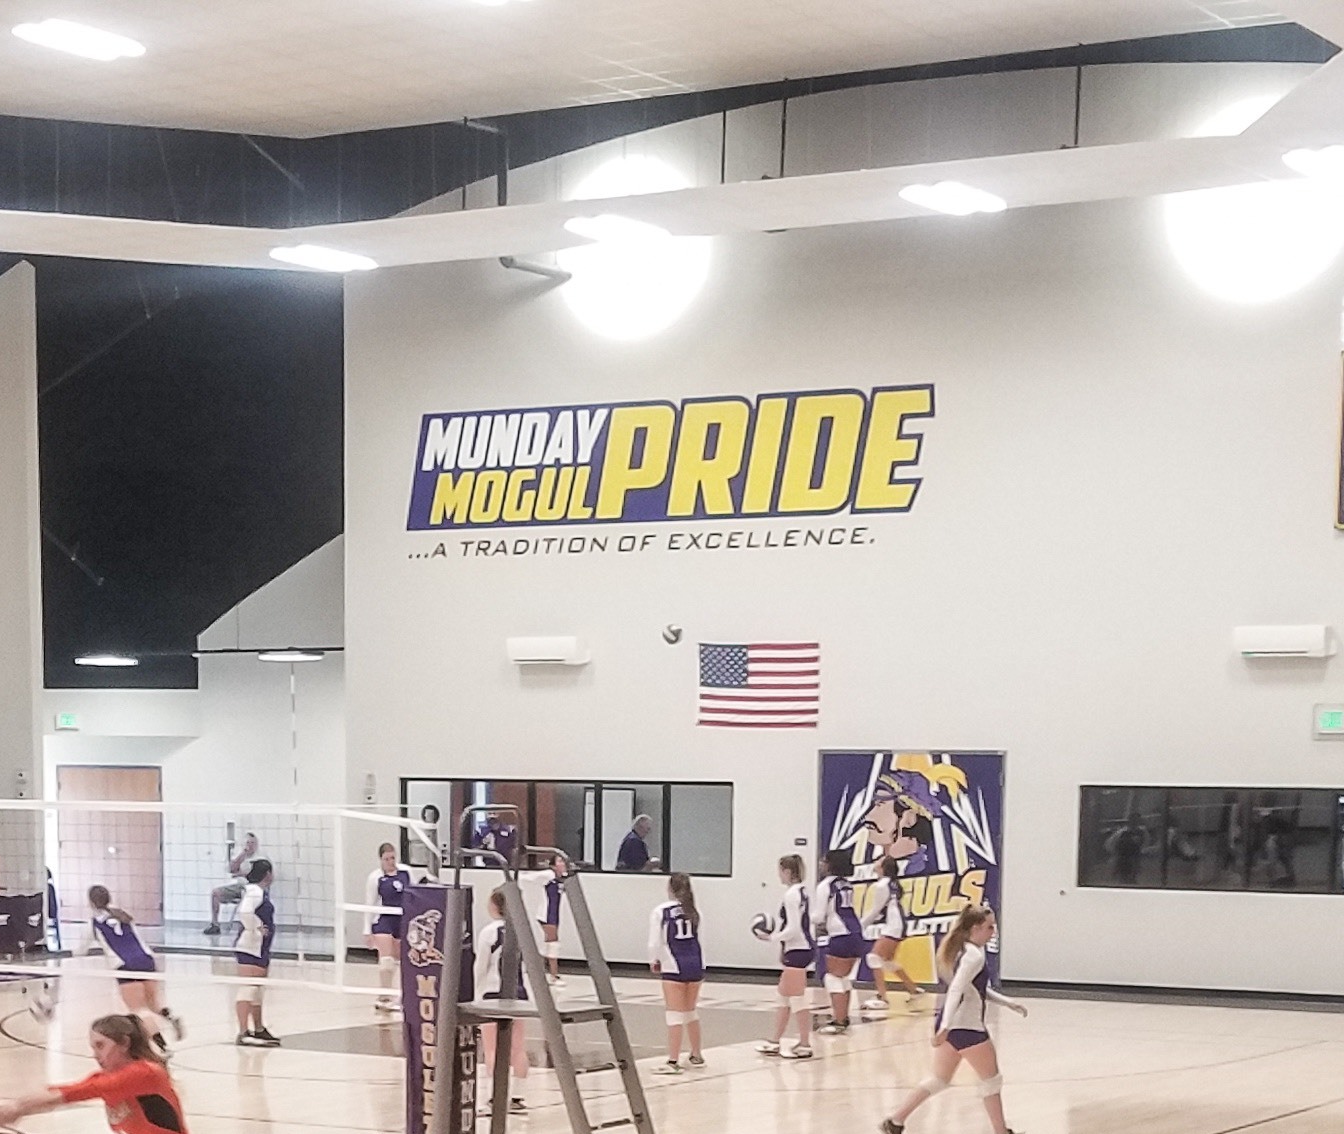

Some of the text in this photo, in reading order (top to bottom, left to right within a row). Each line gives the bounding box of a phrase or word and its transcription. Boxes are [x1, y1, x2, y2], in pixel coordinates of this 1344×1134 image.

[422, 409, 609, 471] MUNDAY
[595, 388, 934, 519] PRIDE
[429, 466, 593, 525] MOGUL
[459, 535, 609, 558] TRADITION
[617, 534, 657, 553] OF
[667, 526, 877, 551] EXCELLENCE.
